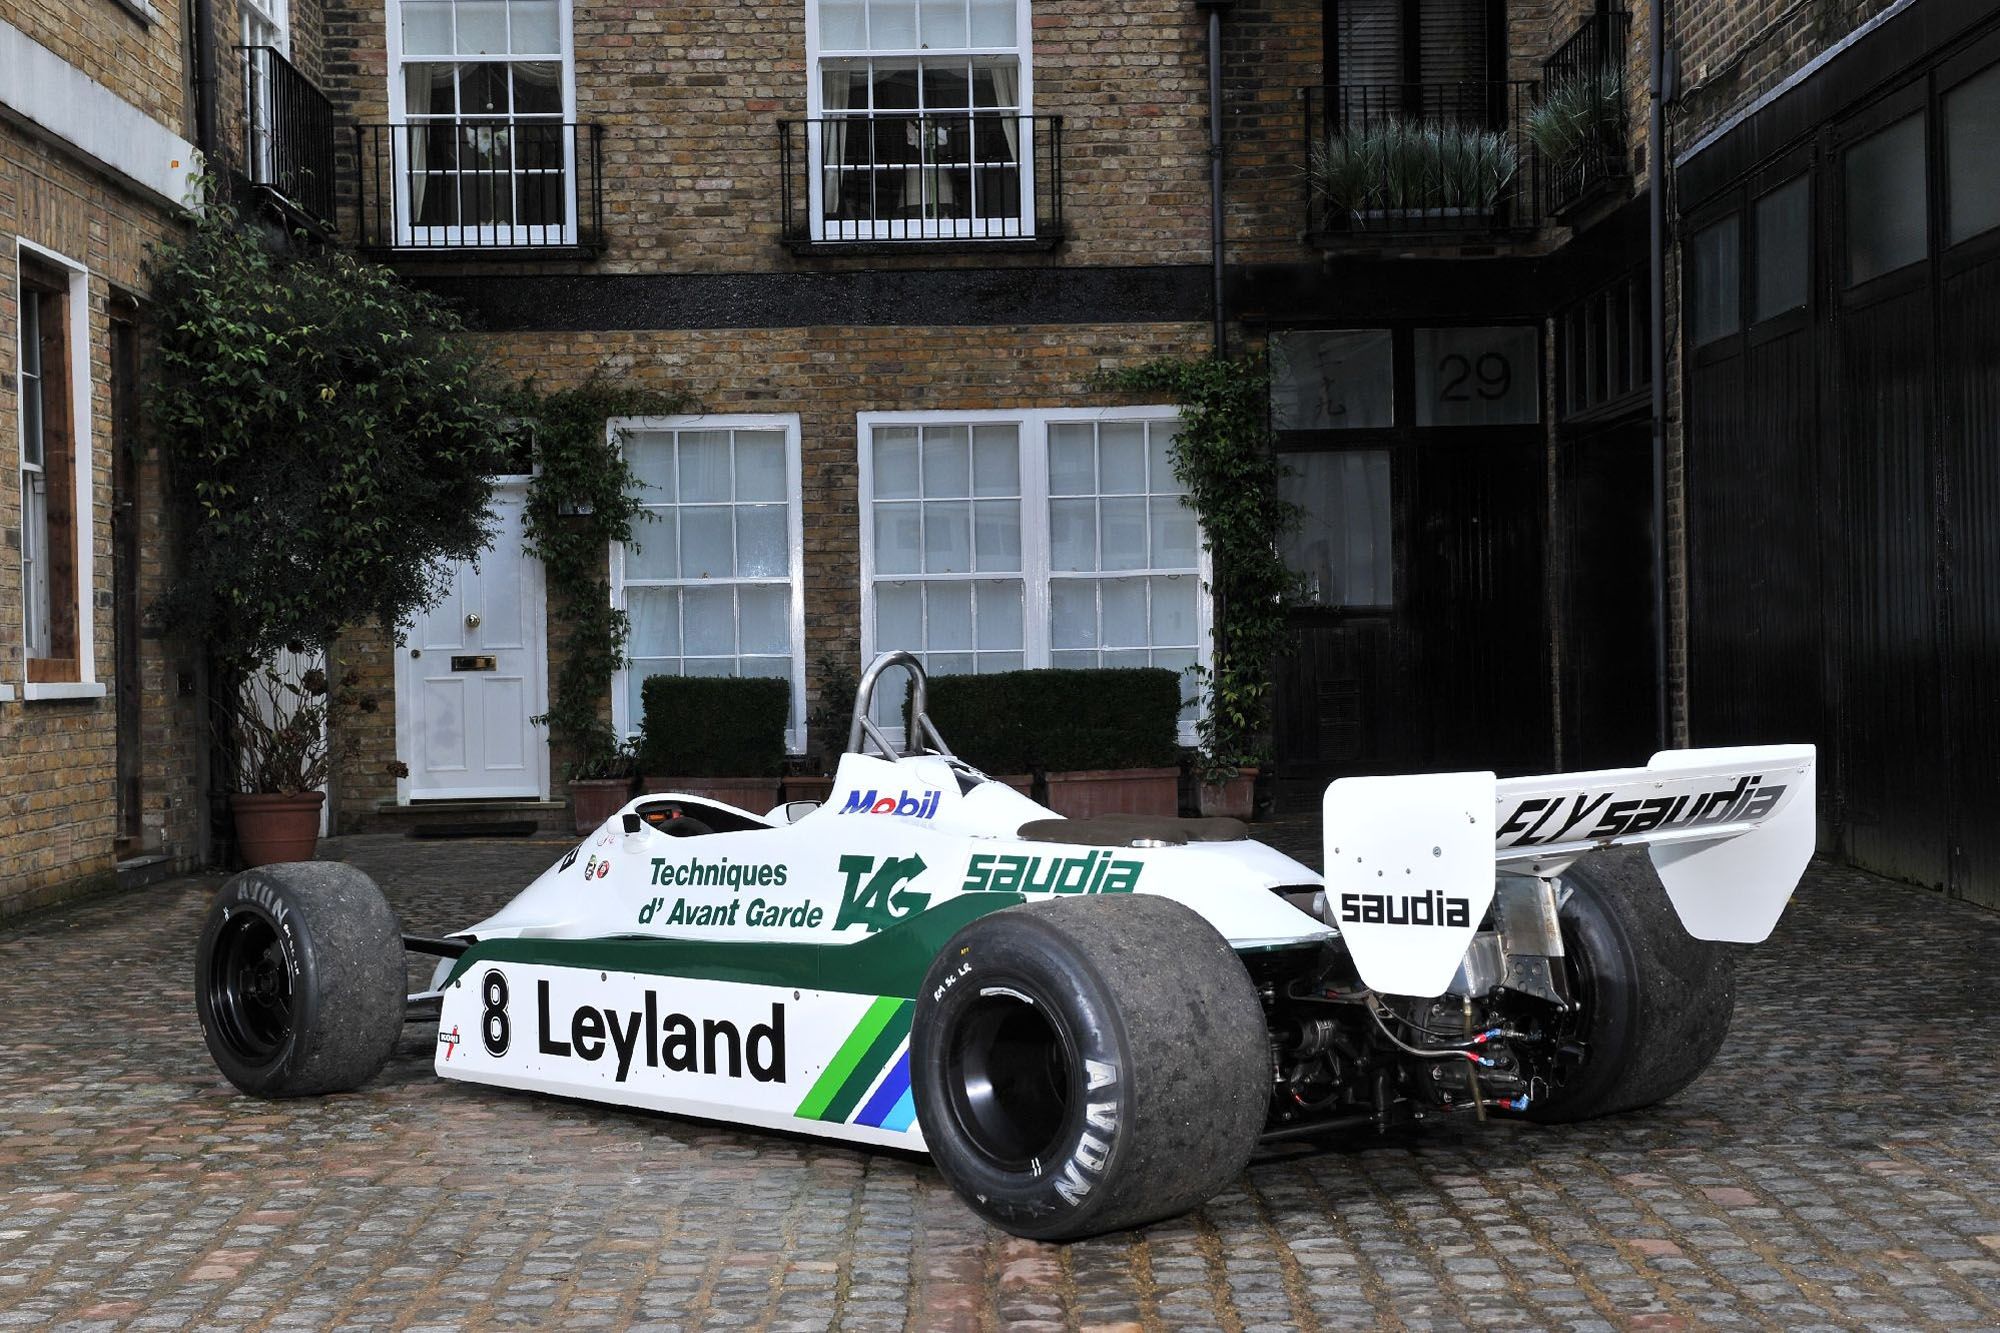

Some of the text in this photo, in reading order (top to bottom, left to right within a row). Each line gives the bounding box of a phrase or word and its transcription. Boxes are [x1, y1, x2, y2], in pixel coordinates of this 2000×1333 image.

[1438, 351, 1512, 403] 29
[838, 790, 942, 819] Mobil
[1496, 775, 1787, 847] FLY saudia
[650, 857, 788, 892] Techniques
[832, 852, 932, 933] TAG
[962, 850, 1145, 895] saudia
[665, 897, 741, 926] Avant
[745, 897, 824, 928] Garde
[1341, 889, 1470, 927] saudia
[958, 962, 973, 977] LR
[481, 968, 512, 1058] 8
[537, 979, 787, 1084] Leyland
[1053, 1058, 1118, 1208] AVON
